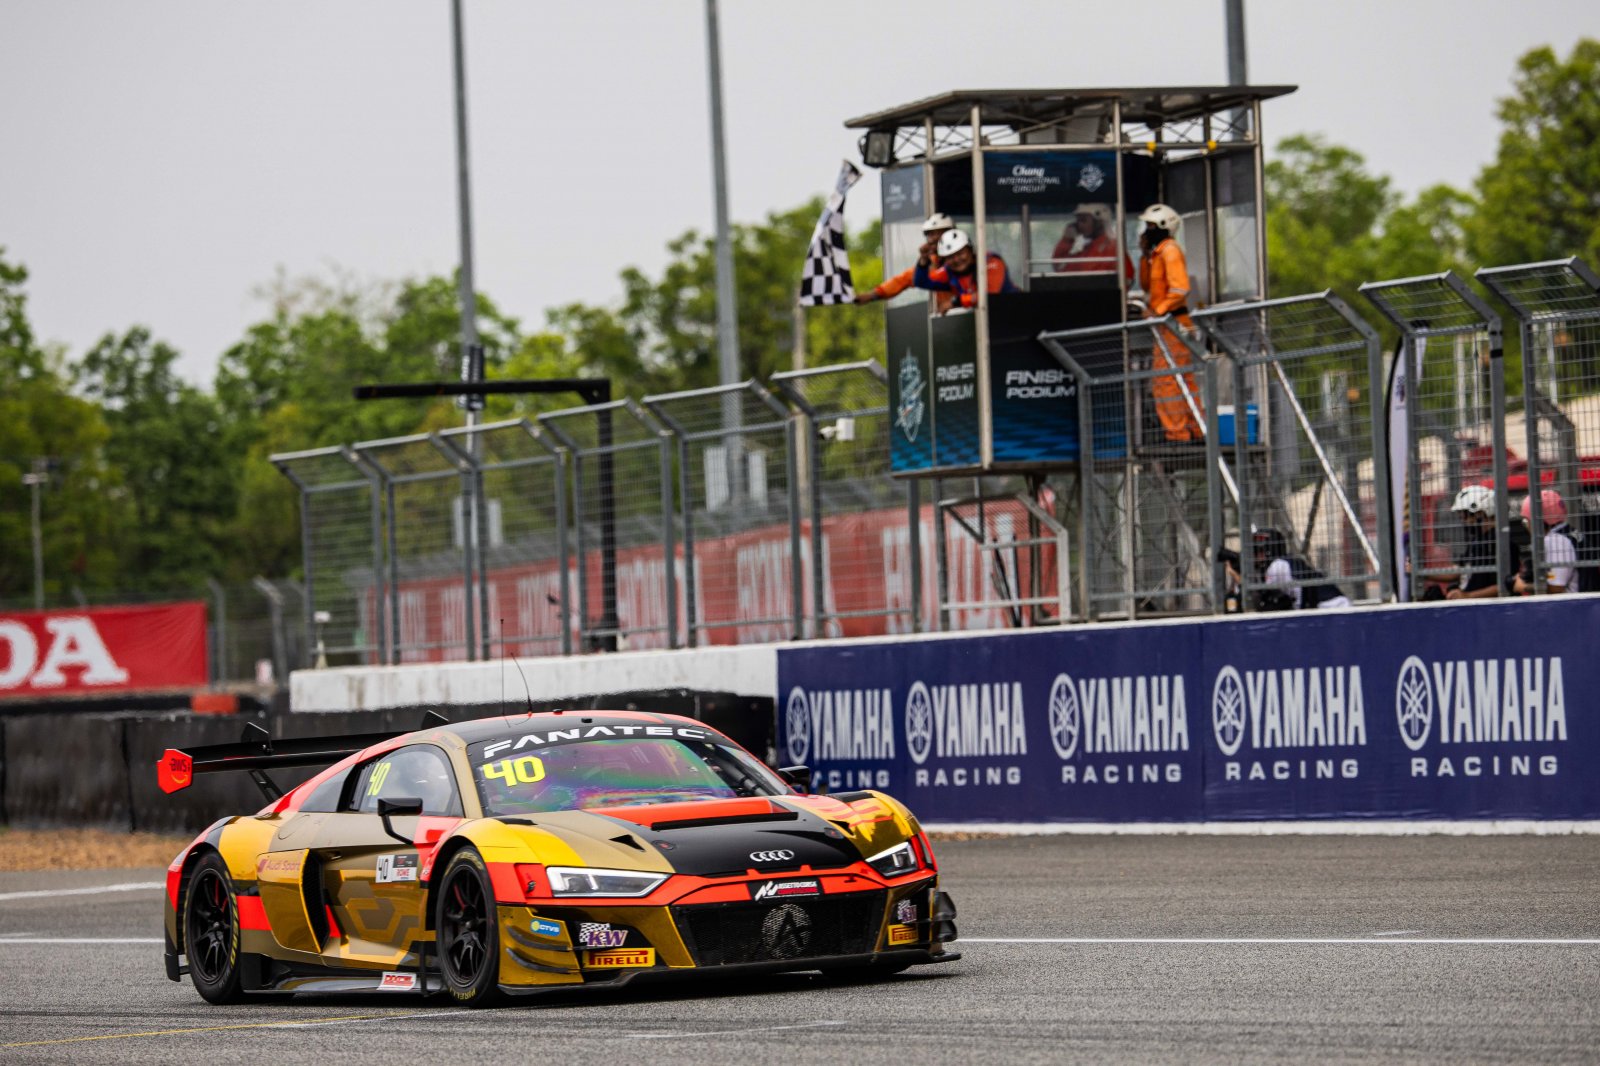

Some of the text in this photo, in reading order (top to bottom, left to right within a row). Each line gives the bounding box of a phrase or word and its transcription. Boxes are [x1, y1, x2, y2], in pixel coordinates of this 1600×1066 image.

[1006, 386, 1076, 399] PODIUM
[1078, 674, 1190, 753] YAMAHA
[1245, 665, 1367, 749] YAMAHA
[1432, 656, 1568, 744] YAMAHA
[809, 688, 896, 760] YAMAHA
[931, 682, 1027, 758] YAMAHA
[483, 726, 706, 759] FANATEC
[367, 762, 392, 796] 40
[482, 755, 546, 787] 40
[811, 769, 890, 788] ACING
[915, 766, 1021, 787] RACING
[1061, 763, 1182, 784] RACING
[1225, 759, 1359, 781] RACING
[1411, 756, 1558, 777] RACING
[587, 930, 628, 947] KW
[588, 950, 649, 966] PIRELLI
